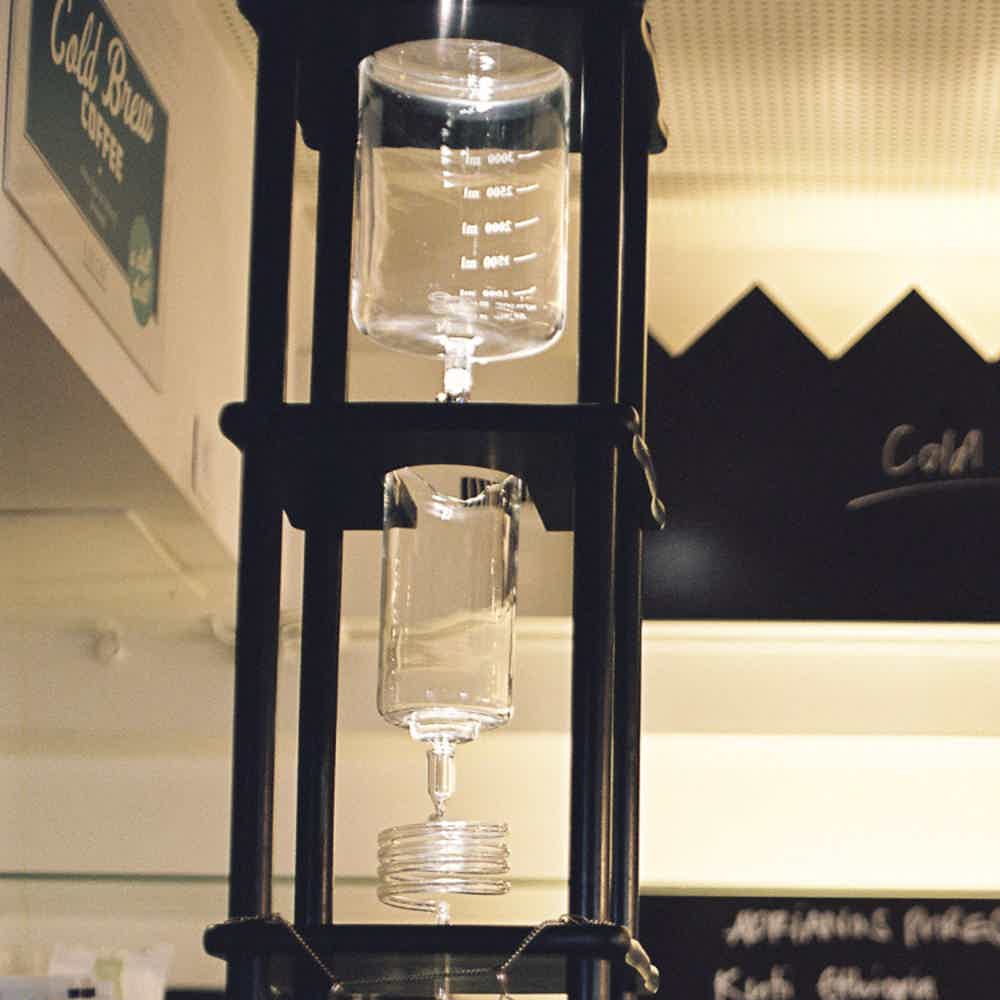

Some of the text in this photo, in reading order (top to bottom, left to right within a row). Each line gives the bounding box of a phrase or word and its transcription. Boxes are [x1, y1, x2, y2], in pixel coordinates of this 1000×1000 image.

[51, 0, 154, 144] Cold Brew
[882, 425, 984, 475] Cold
